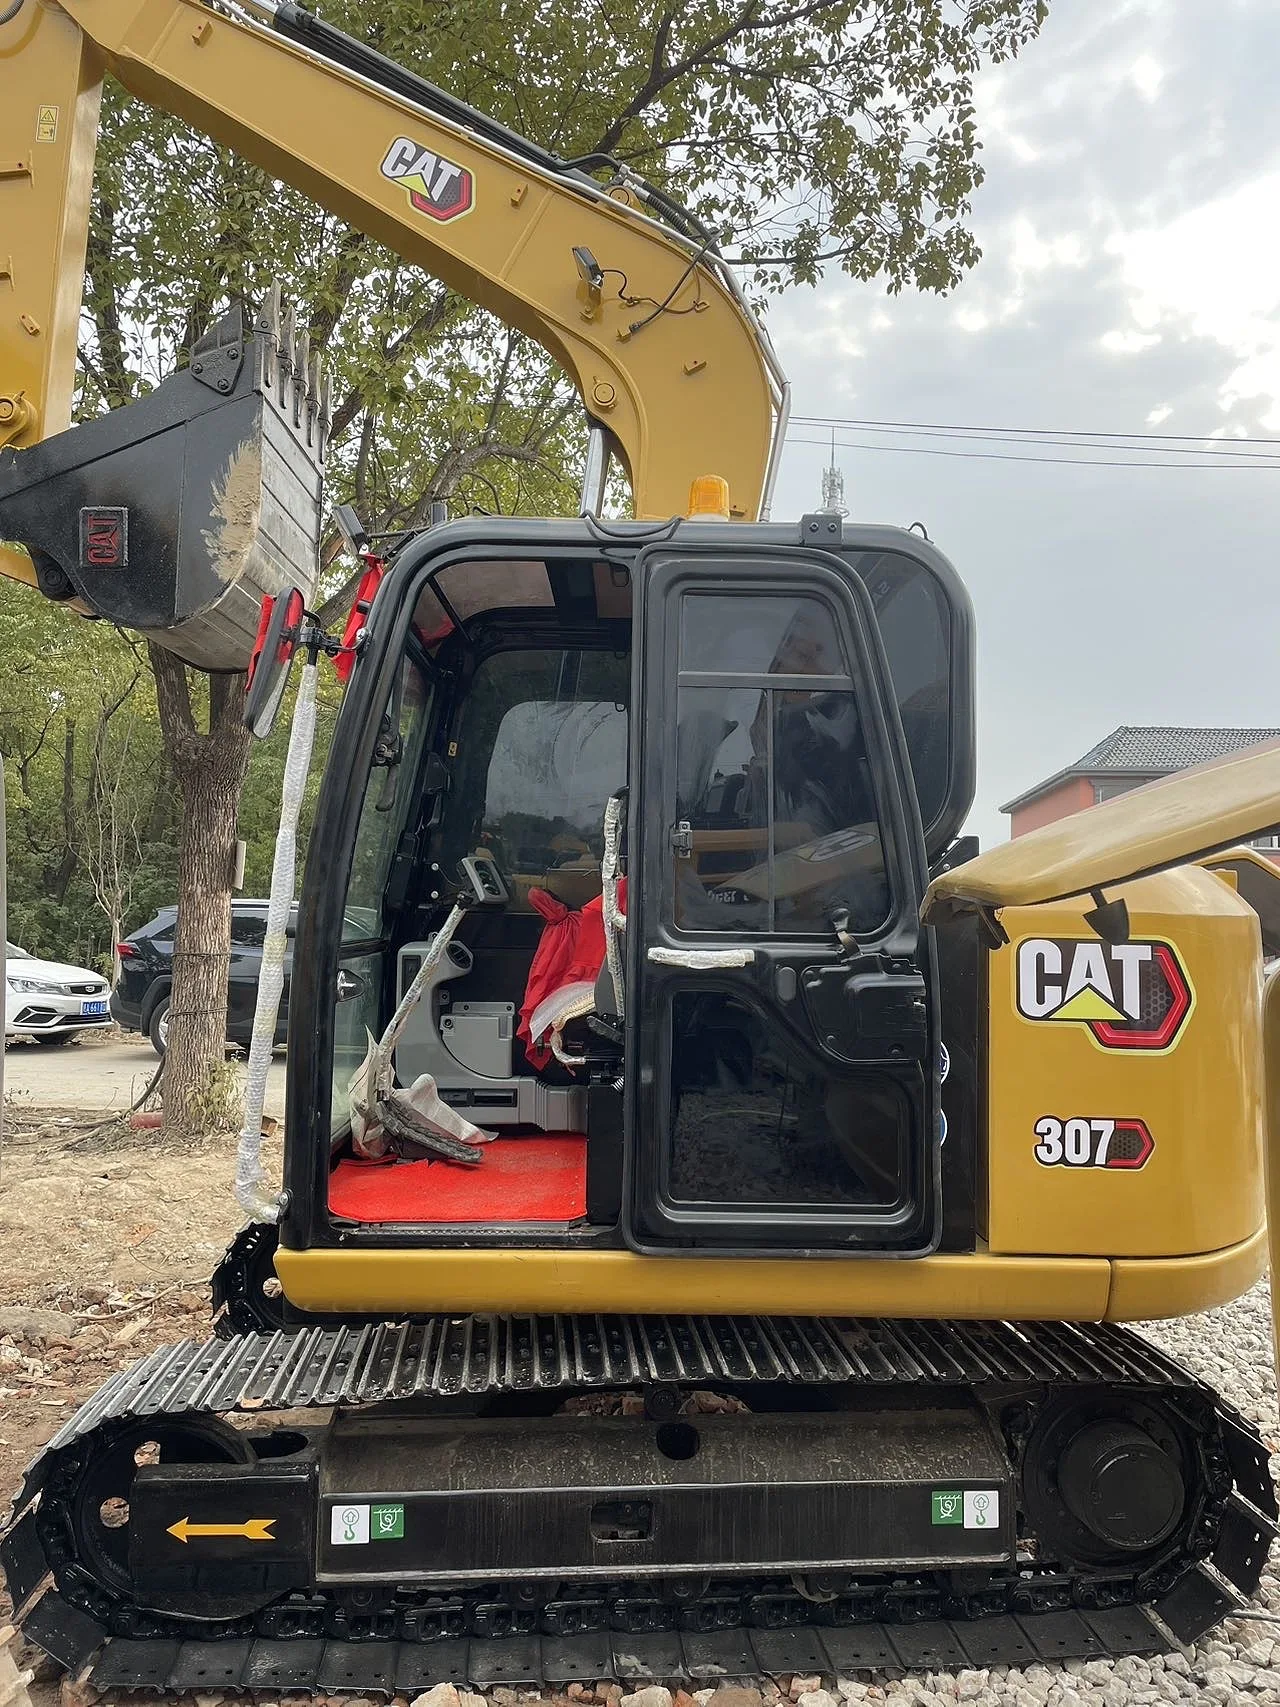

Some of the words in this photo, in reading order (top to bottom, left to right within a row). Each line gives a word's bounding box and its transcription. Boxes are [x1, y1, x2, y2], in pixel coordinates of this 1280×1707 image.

[382, 138, 461, 201] CAT
[88, 514, 119, 563] CAT
[1019, 939, 1152, 1020] CAT
[1036, 1118, 1115, 1165] 307
